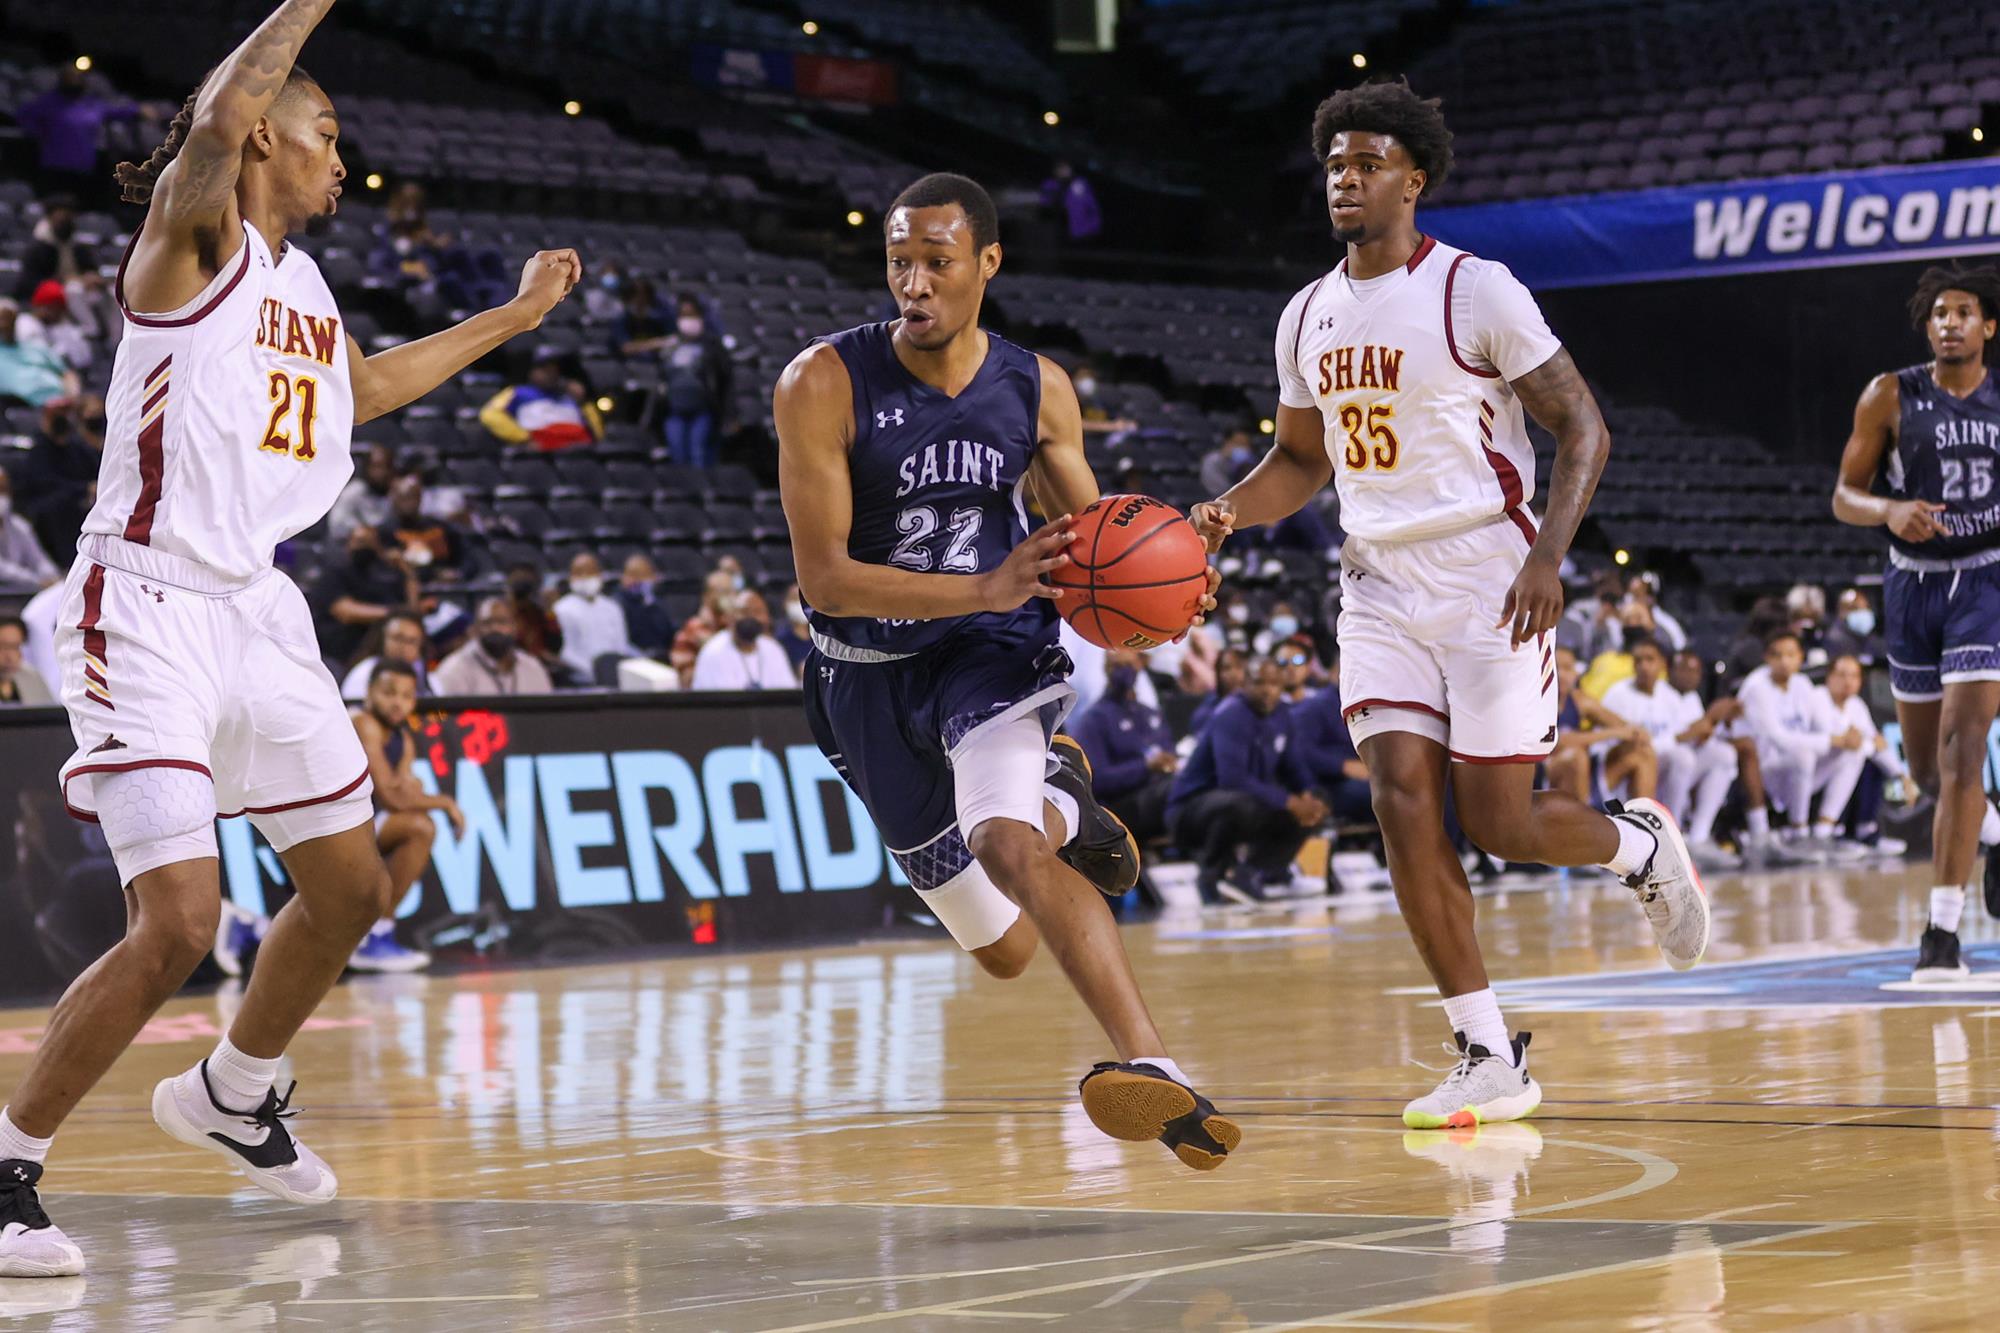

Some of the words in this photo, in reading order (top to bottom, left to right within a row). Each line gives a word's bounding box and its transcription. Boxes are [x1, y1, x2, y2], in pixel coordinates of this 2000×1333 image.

[255, 297, 339, 367] SHAW
[1317, 345, 1404, 397] SHAW
[258, 369, 318, 462] 21
[1339, 402, 1400, 472] 35
[1935, 419, 2000, 451] SAINT
[896, 439, 1005, 498] SAINT
[1940, 456, 1995, 502] 25
[888, 504, 984, 573] 22
[217, 744, 913, 917] WERAD
